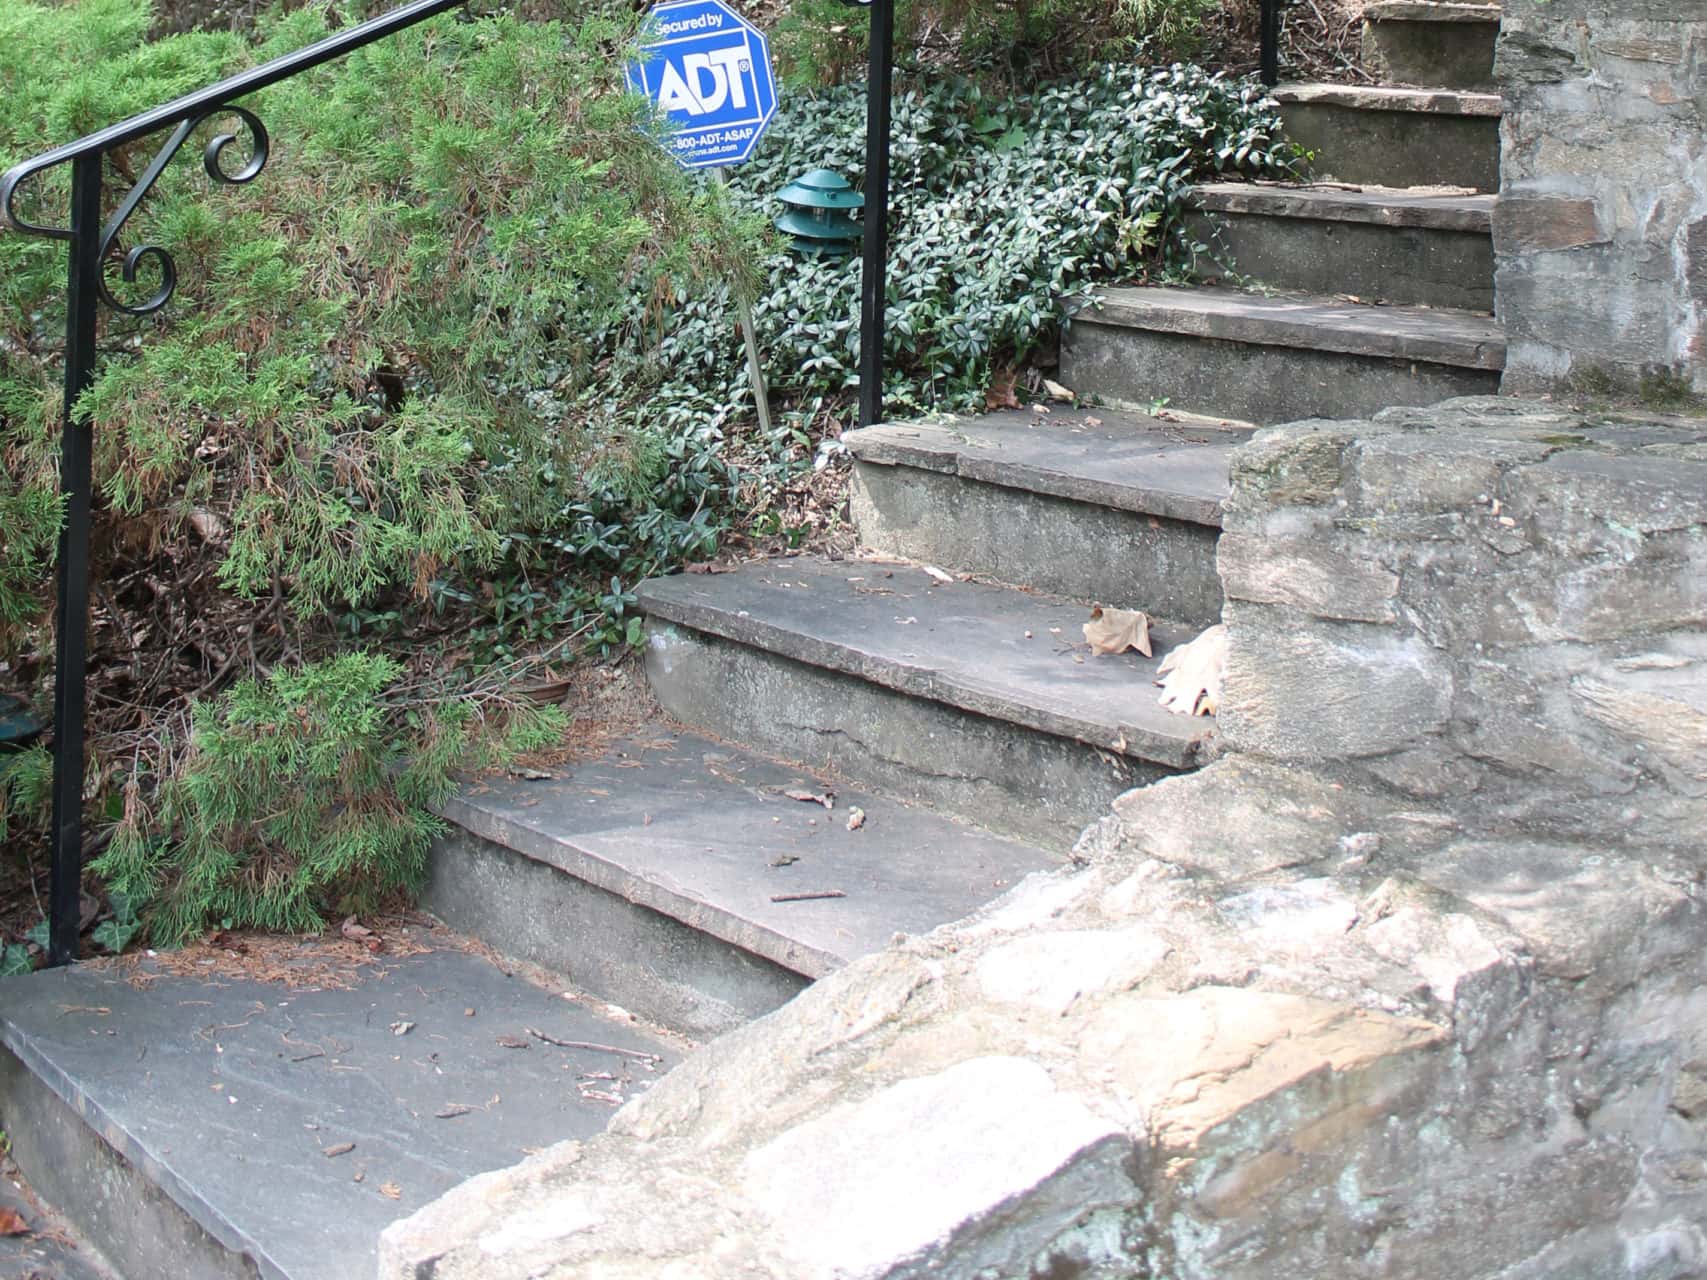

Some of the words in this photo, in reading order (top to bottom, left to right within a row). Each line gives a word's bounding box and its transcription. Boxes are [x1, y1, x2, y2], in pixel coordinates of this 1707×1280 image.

[655, 14, 706, 35] Secured
[706, 13, 723, 28] by
[670, 127, 753, 150] -800-ADT-ASAP
